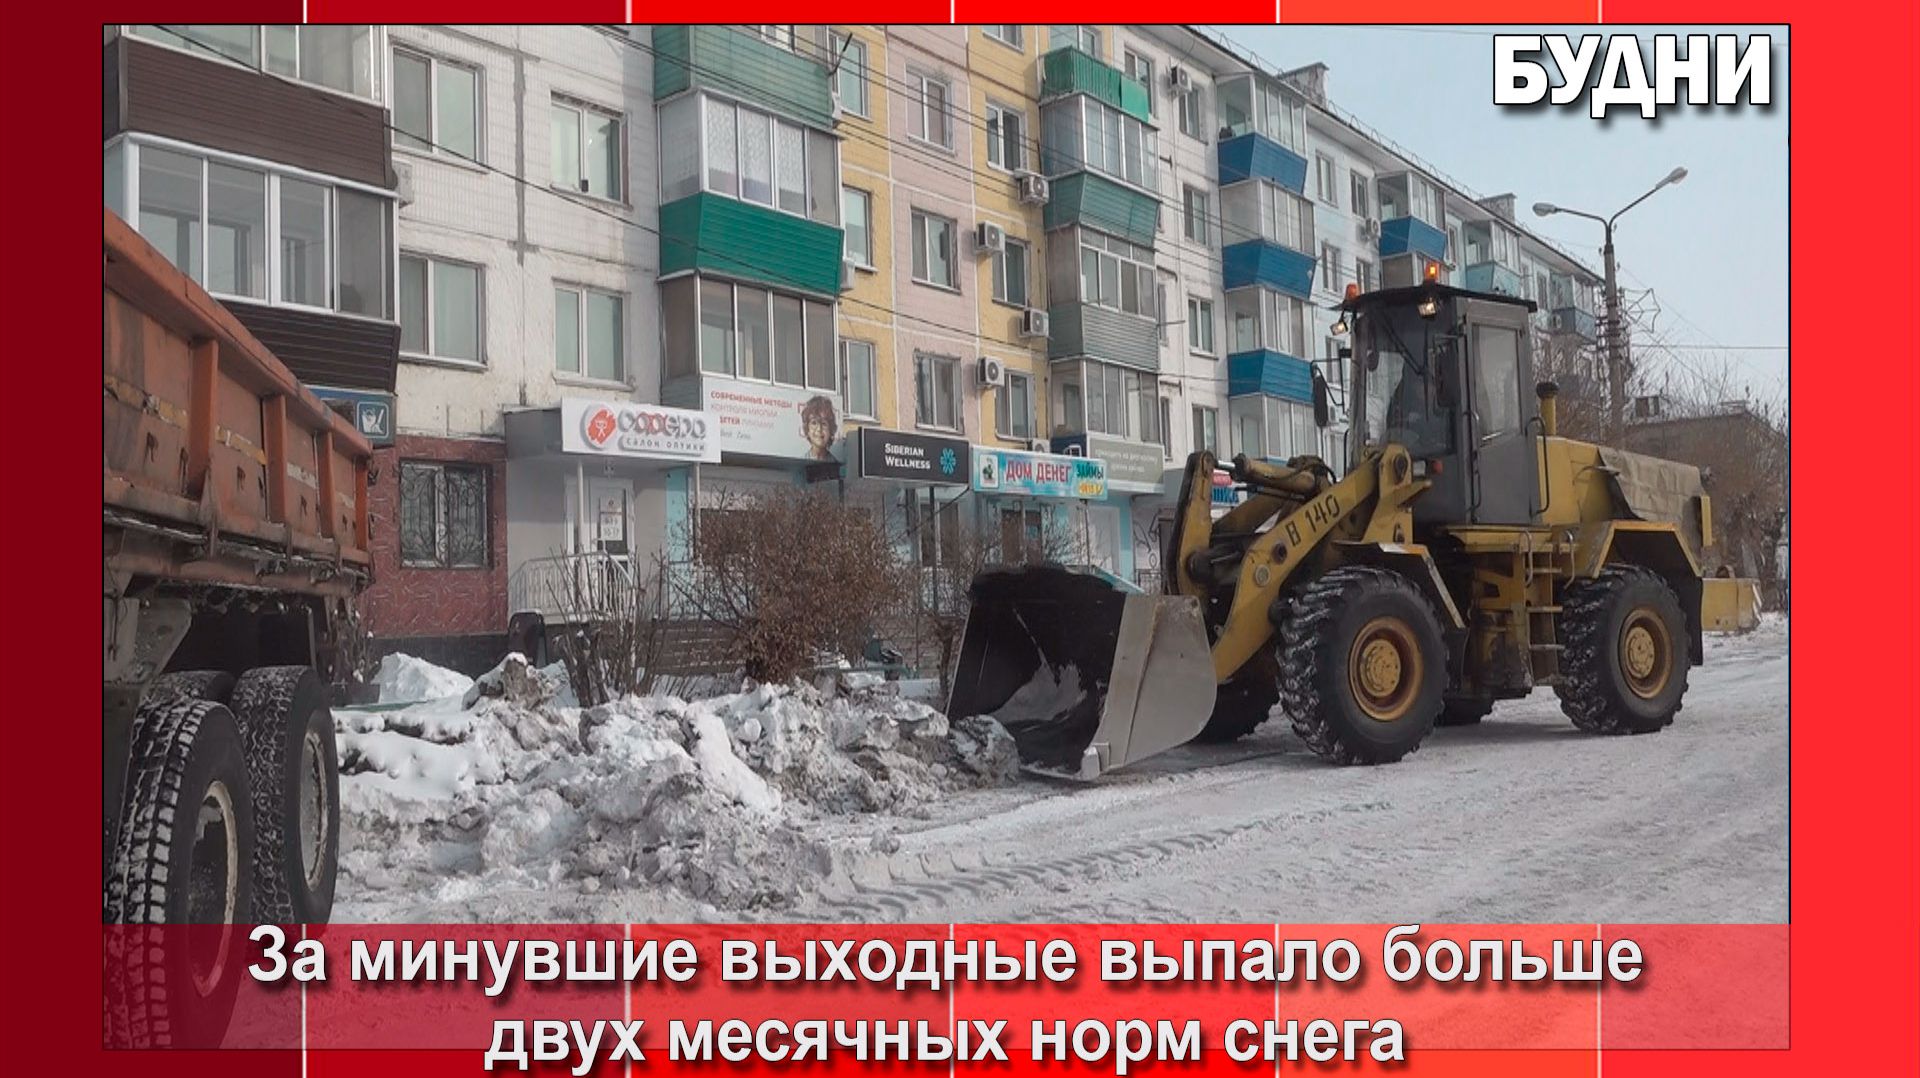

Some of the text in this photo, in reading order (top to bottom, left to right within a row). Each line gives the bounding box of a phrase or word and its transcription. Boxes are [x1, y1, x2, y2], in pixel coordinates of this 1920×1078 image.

[710, 391, 793, 409] СОВРЕМЕННЫЕ МЕТОДЫ
[1006, 460, 1072, 484] ДОМ ДЕНЕГ
[1076, 462, 1104, 480] ЗАЙМЫ
[1305, 494, 1341, 533] 140
